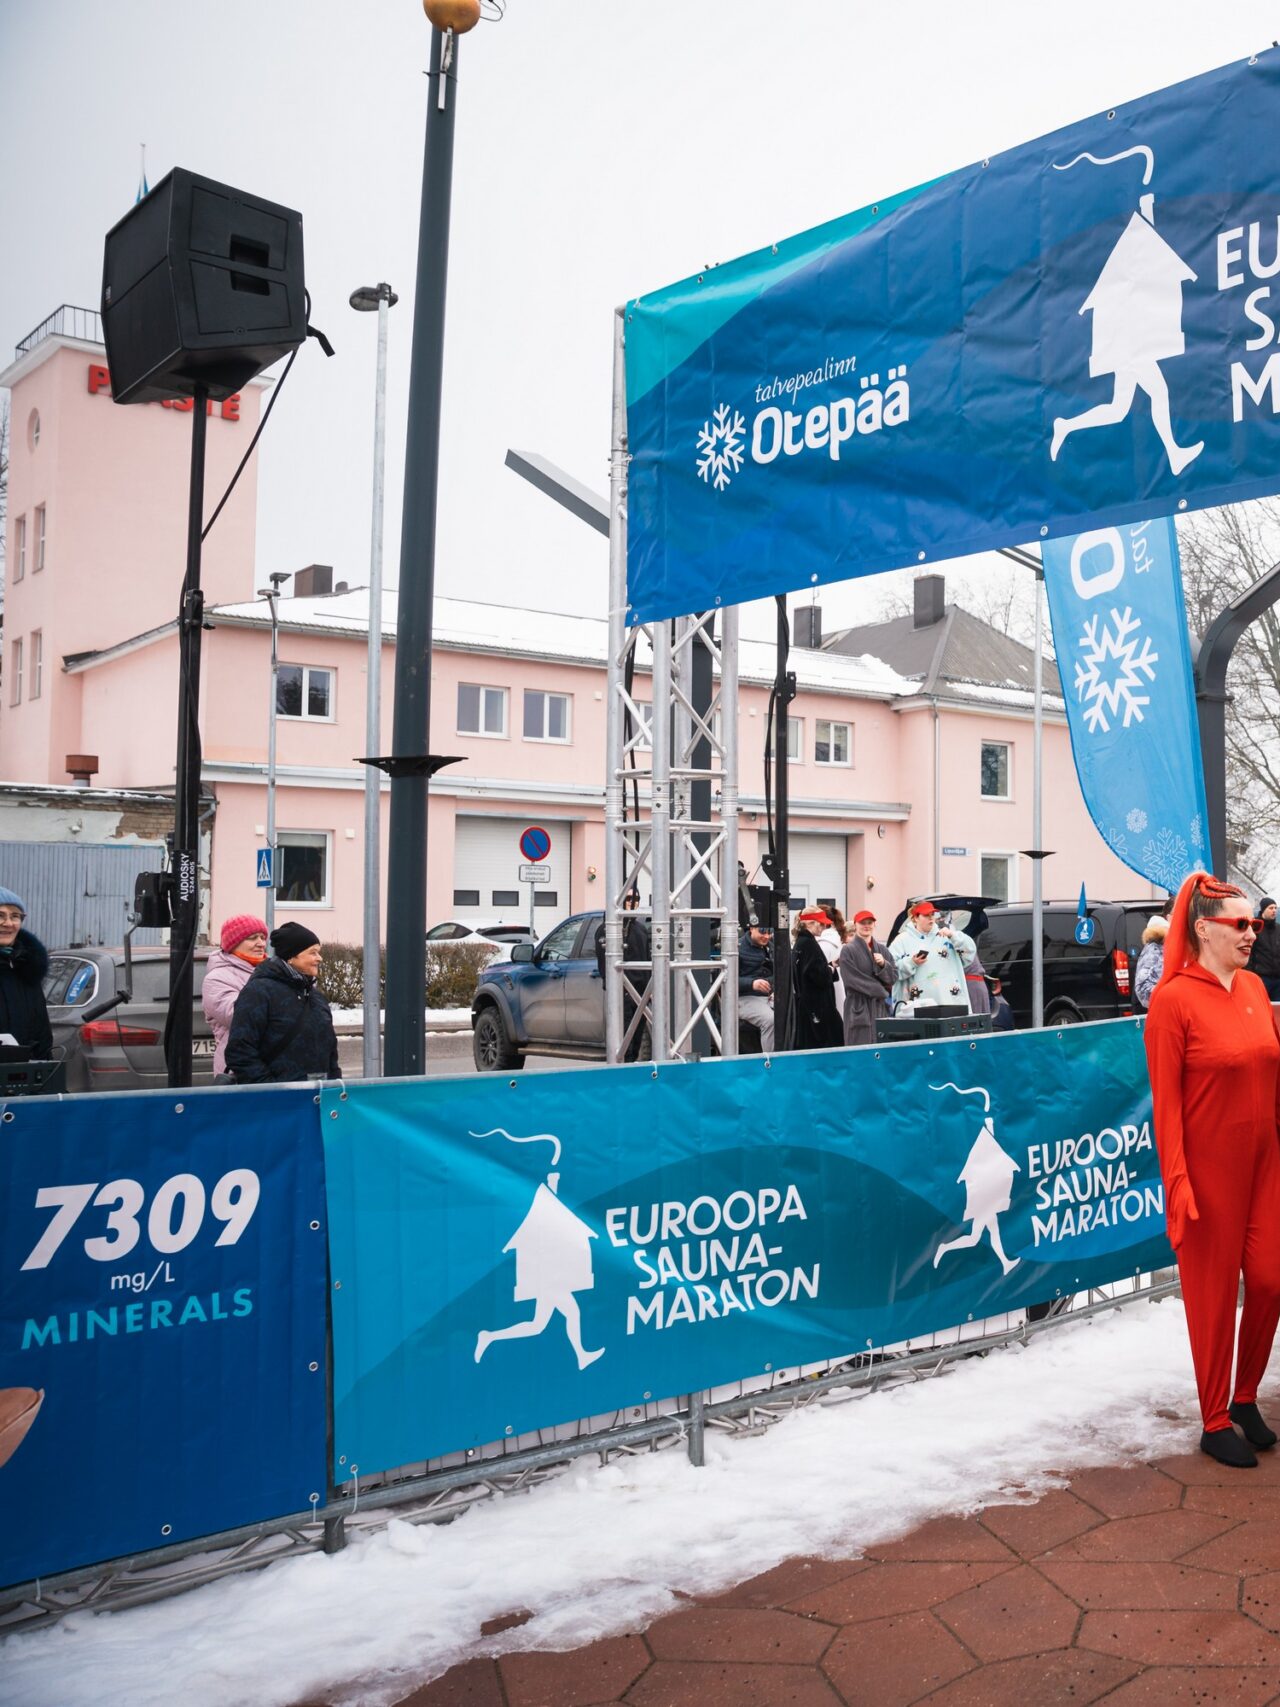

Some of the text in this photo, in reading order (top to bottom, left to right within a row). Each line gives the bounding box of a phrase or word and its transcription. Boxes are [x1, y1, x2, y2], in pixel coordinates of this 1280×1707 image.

[755, 355, 857, 405] talvepealinn
[751, 364, 910, 465] Otepää
[180, 852, 190, 902] AUDIOSKY
[193, 1040, 217, 1054] 715
[1027, 1121, 1153, 1179] EUROOPA
[1036, 1161, 1137, 1211] SAUNA-
[20, 1168, 261, 1271] 7309
[606, 1184, 808, 1248] EUROOPA
[1030, 1184, 1164, 1248] MARATON
[110, 1260, 175, 1293] mg/L
[633, 1232, 783, 1290] SAUNA-
[20, 1288, 253, 1350] MINERALS
[626, 1263, 821, 1336] MARATON
